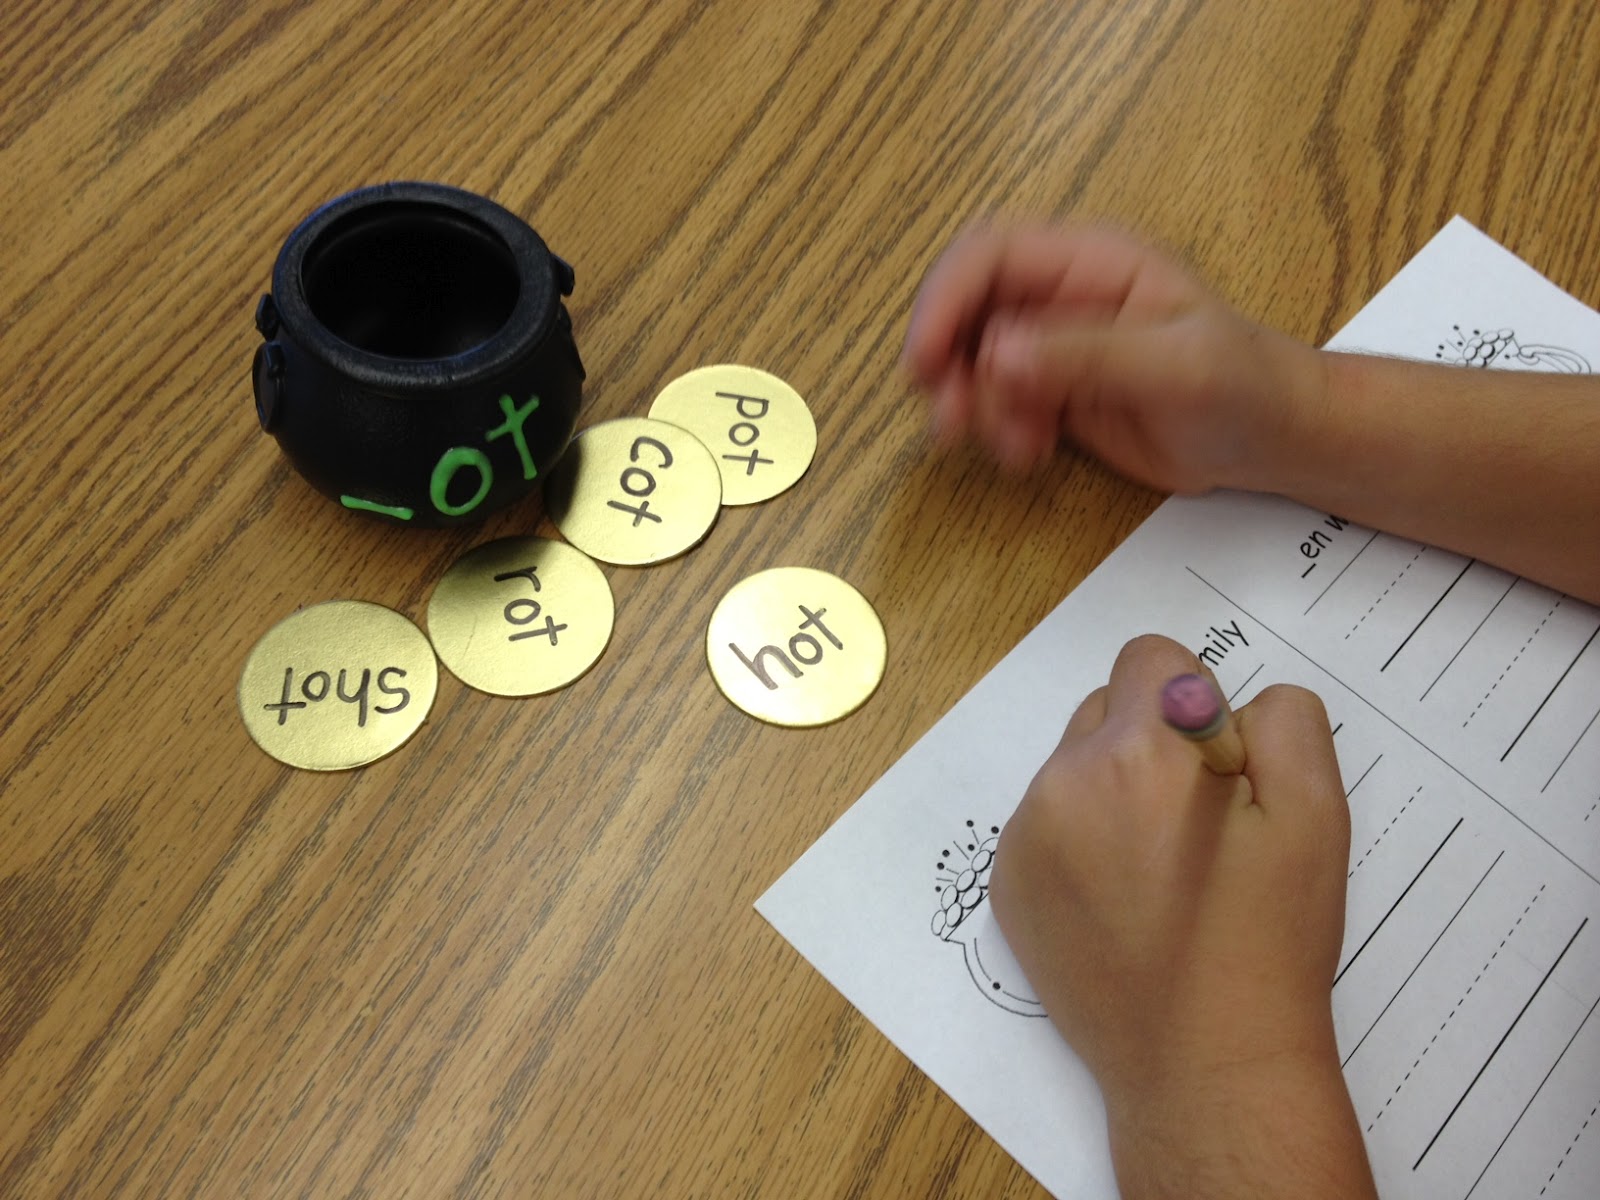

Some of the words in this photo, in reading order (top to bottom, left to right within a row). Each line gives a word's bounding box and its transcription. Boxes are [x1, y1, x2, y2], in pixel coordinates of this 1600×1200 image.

[715, 391, 774, 475] pot
[607, 435, 673, 528] cot
[493, 566, 567, 646] rot
[728, 604, 843, 690] hot
[1198, 620, 1249, 666] mily
[264, 665, 410, 728] shot
